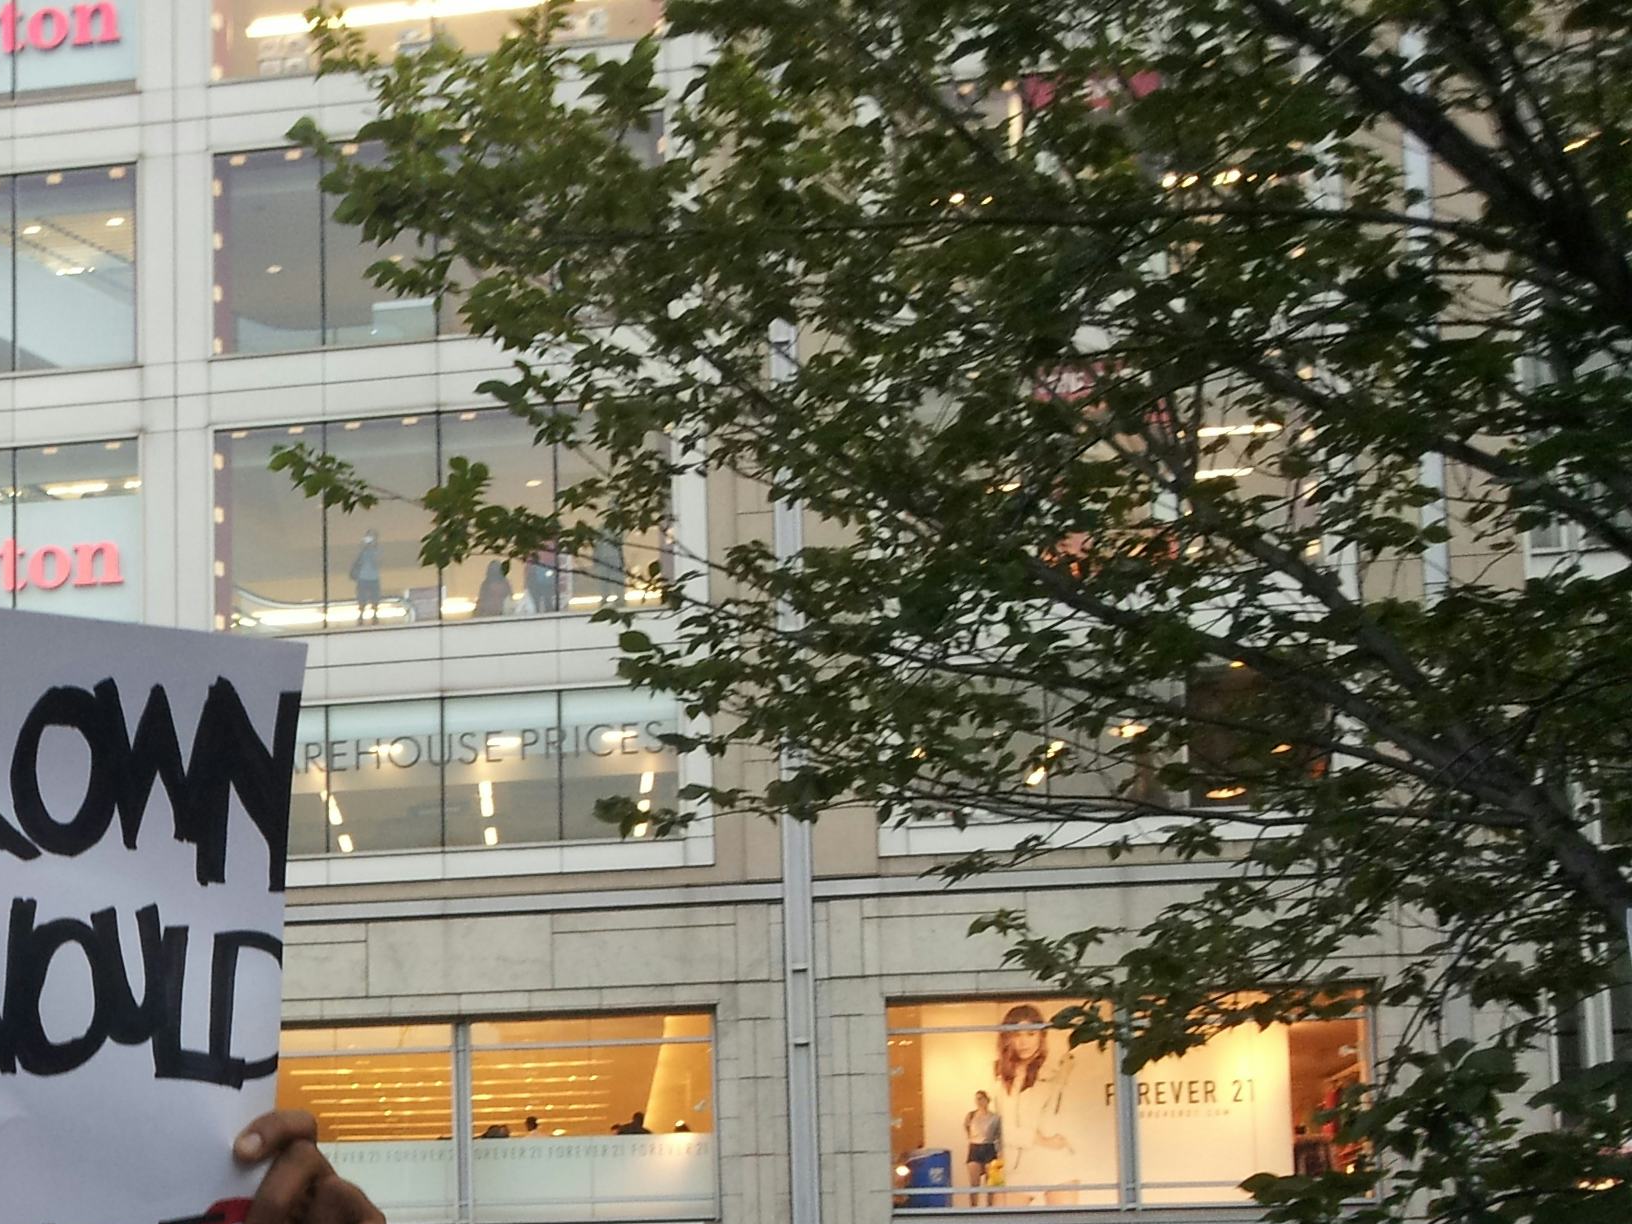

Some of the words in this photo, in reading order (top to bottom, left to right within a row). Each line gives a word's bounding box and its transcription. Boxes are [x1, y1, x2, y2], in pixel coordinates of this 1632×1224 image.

[294, 730, 504, 774] REHOUSE
[520, 720, 666, 761] PRICES
[1105, 1080, 1217, 1107] FREVER
[1232, 1079, 1256, 1103] 21
